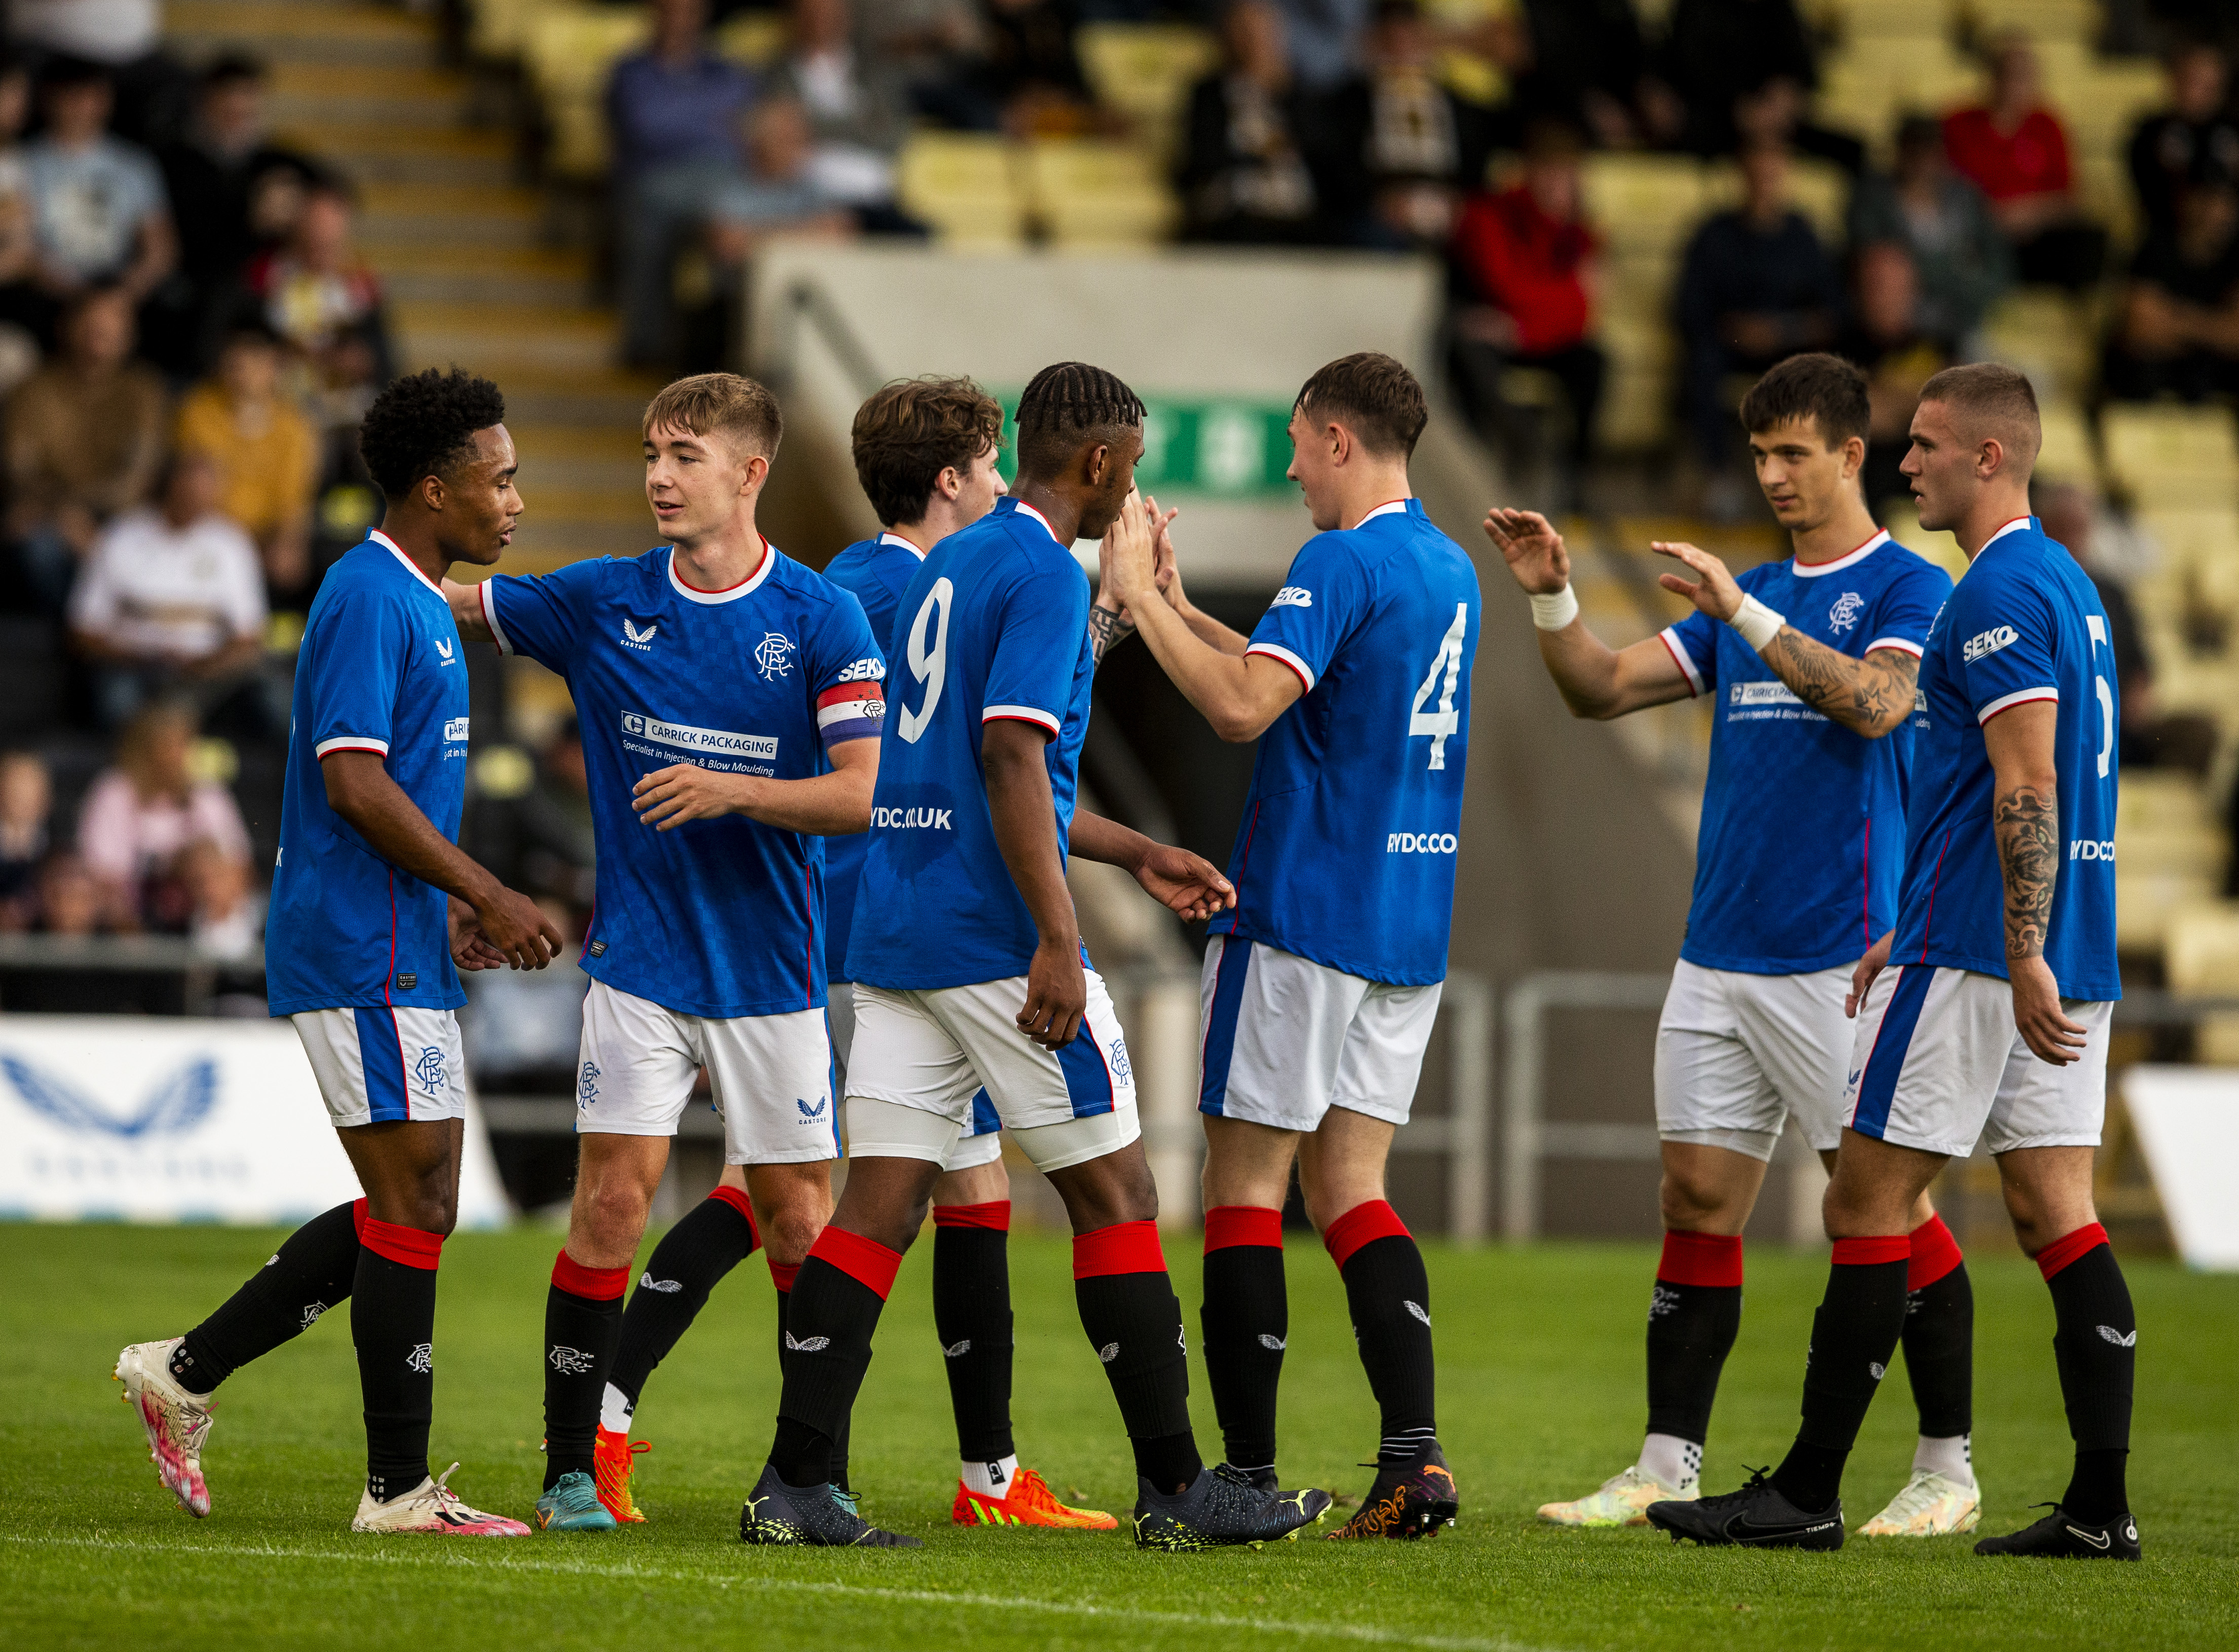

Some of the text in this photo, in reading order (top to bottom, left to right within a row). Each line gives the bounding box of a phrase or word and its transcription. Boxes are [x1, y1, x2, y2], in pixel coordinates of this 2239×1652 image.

[1271, 586, 1312, 608] EKO
[620, 640, 651, 651] CASTORE
[1963, 625, 2019, 663] SEKO
[898, 577, 954, 744] 9
[1409, 602, 1467, 770] 4
[652, 724, 774, 754] CARRICK PACKAGING
[623, 740, 774, 777] Specialist in Injection & Blow Moulding
[870, 807, 952, 830] YDC.CO.UK
[1805, 1522, 1836, 1532] TIEMPO
